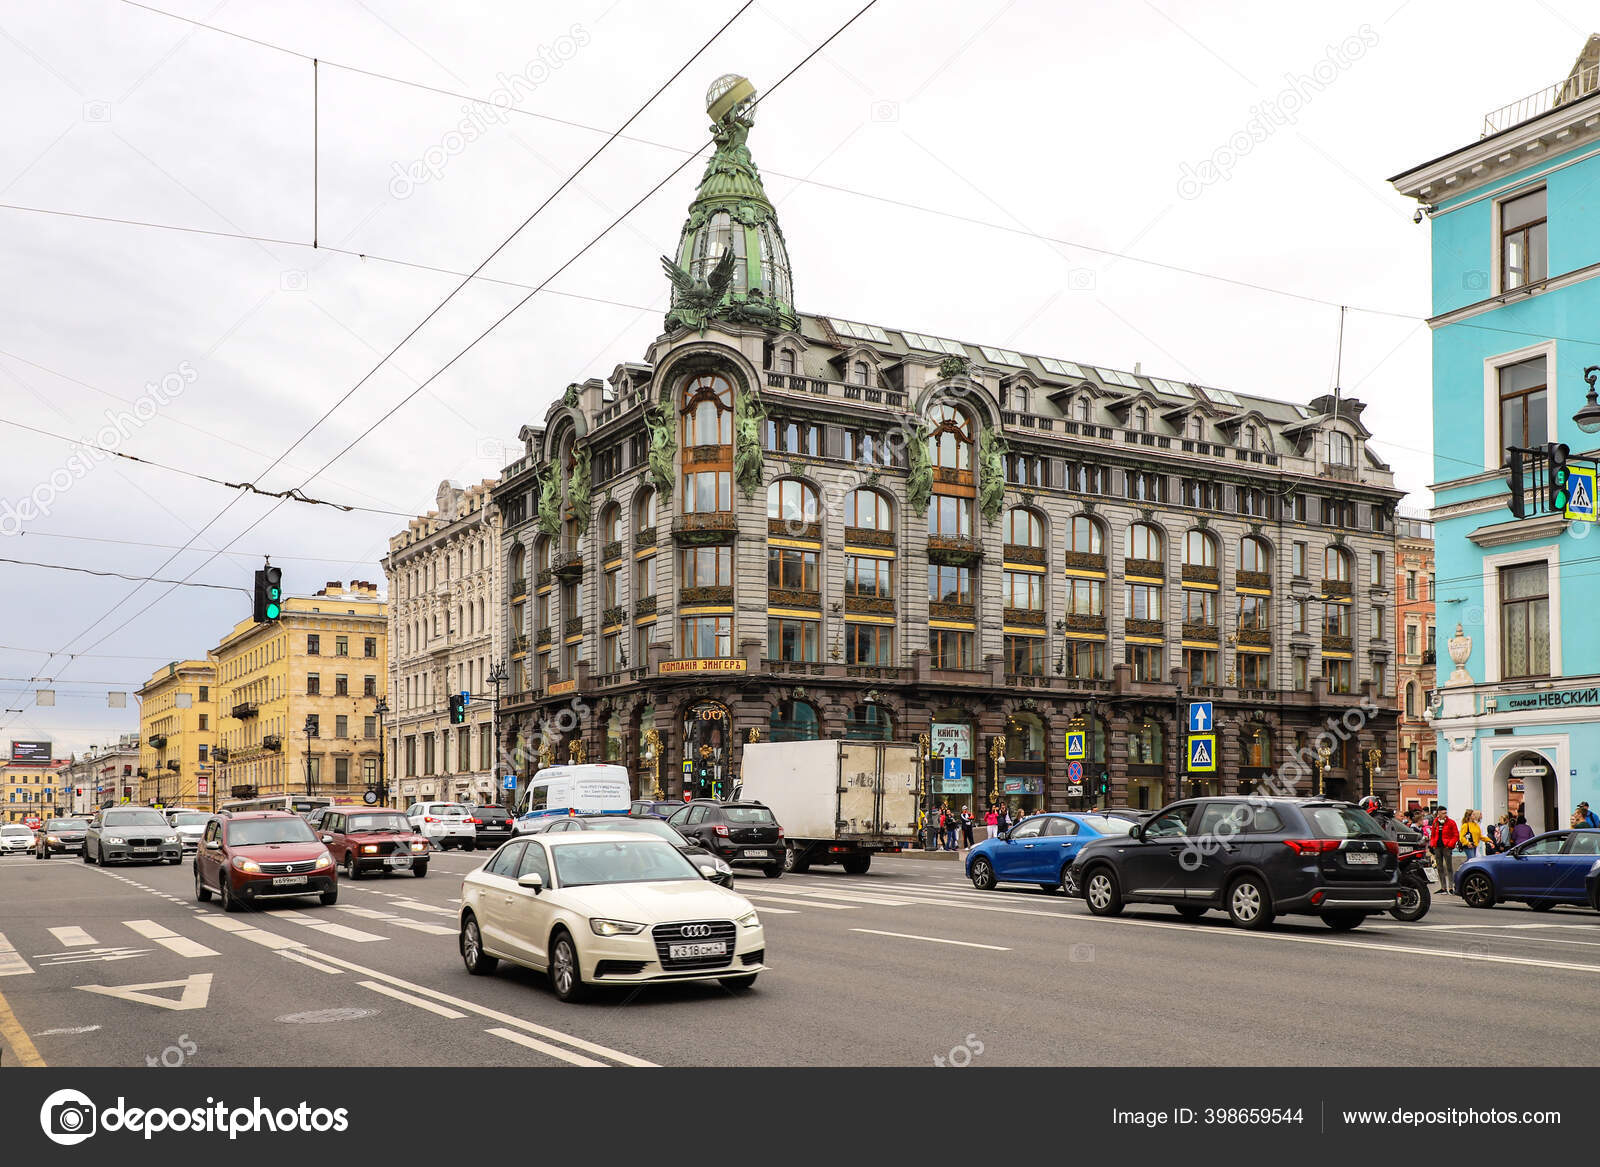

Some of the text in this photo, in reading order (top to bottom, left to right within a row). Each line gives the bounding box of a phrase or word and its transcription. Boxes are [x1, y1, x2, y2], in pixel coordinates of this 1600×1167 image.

[271, 588, 278, 600] 9
[702, 660, 741, 670] ЗИНГЕРЪ
[1509, 687, 1599, 708] СТАНЦИЯ НЕВСКИЙ
[937, 728, 959, 738] КНИГИ
[936, 741, 958, 757] 2+1
